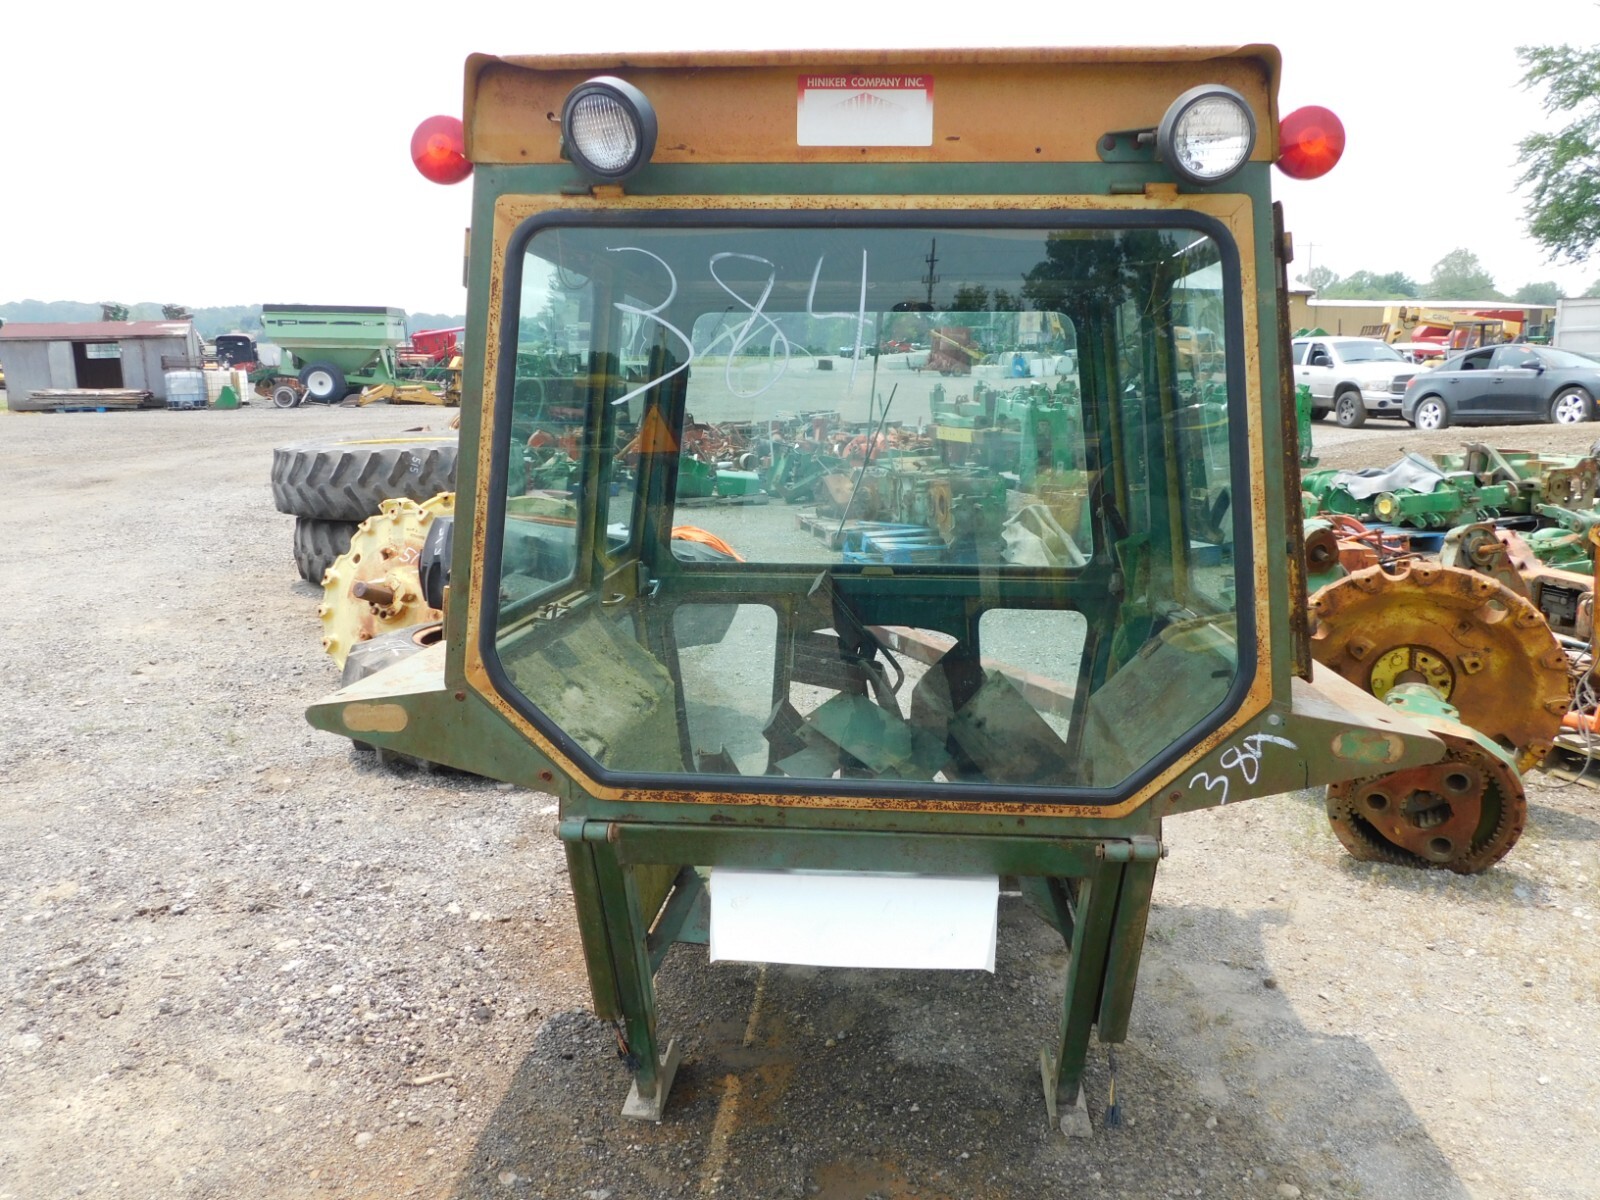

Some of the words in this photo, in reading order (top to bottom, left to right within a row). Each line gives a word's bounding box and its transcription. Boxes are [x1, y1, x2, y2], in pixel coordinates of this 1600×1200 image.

[807, 77, 847, 87] HINIKER
[851, 77, 901, 87] COMPANY
[904, 77, 925, 87] INC.
[606, 246, 873, 405] 384
[409, 455, 421, 474] 515
[1188, 731, 1298, 806] 384
